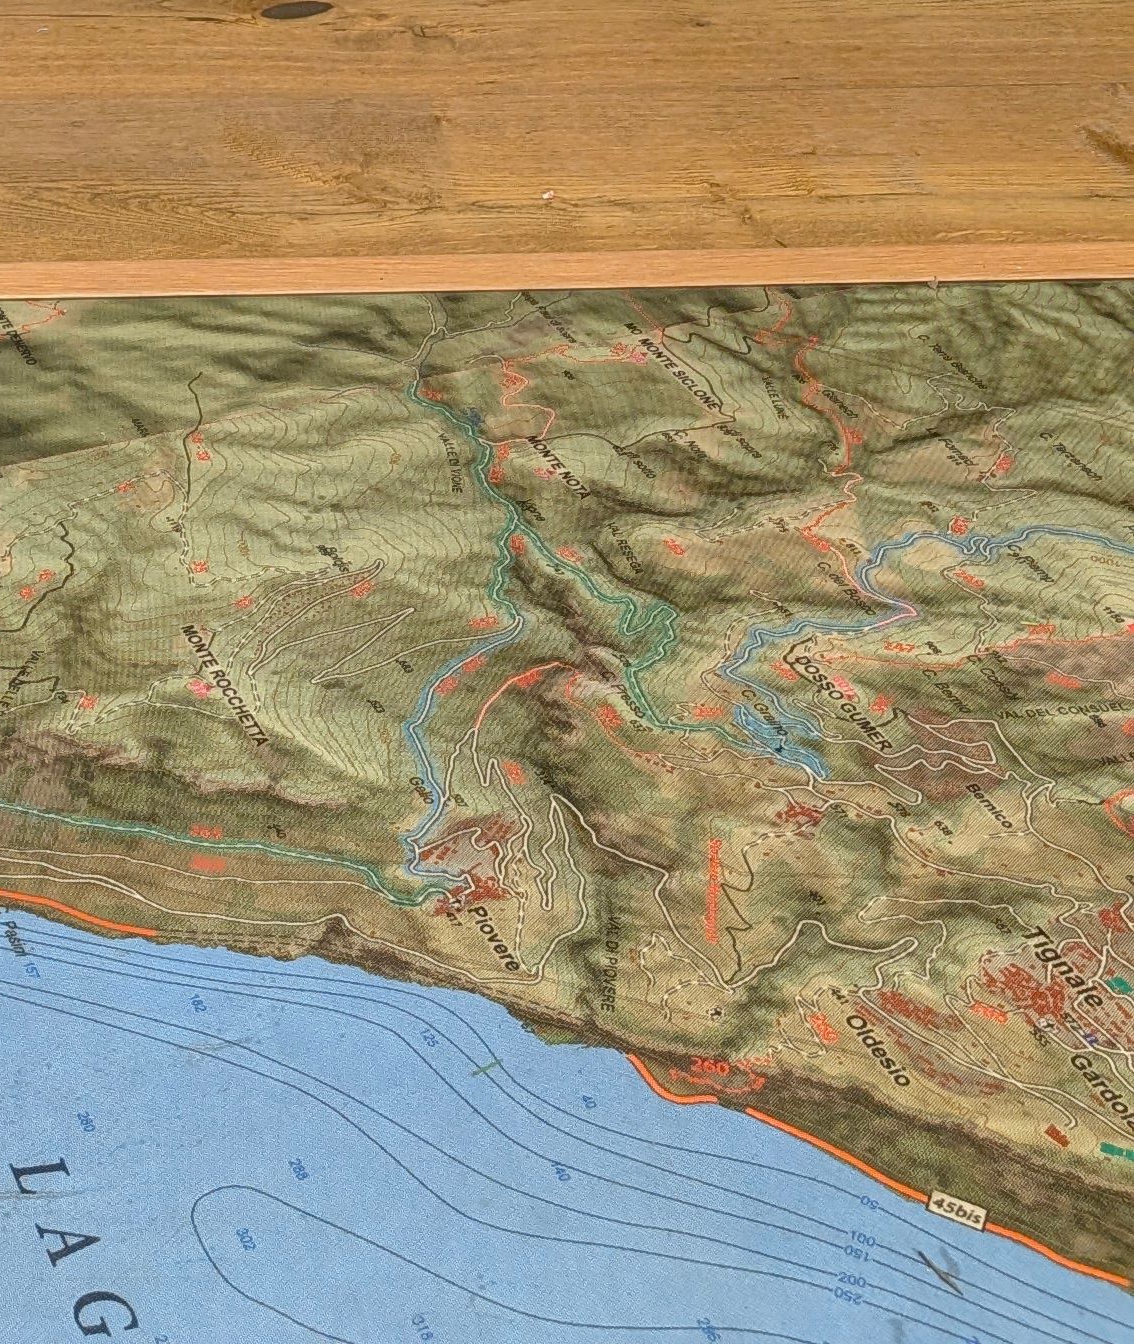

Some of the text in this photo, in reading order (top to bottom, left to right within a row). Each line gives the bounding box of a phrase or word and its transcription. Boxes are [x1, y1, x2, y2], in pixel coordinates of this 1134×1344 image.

[638, 338, 720, 411] MONTE SICLONE
[527, 435, 563, 472] MONTE
[560, 470, 591, 500] NOTA
[616, 537, 641, 575] RESEGA
[180, 624, 269, 748] MONTE ROCCHETTA
[794, 655, 894, 752] DOSSO GUMER
[1025, 701, 1130, 717] DEL CONSUEL
[752, 699, 788, 738] Graino
[933, 819, 953, 837] 638
[467, 905, 520, 973] Piovere
[1022, 926, 1104, 1009] Tignale
[419, 1027, 440, 1048] 125
[845, 1014, 911, 1088] Oldesio
[690, 1058, 730, 1076] 260
[77, 1111, 96, 1133] 280
[931, 1197, 983, 1225] 45bis
[235, 1226, 257, 1252] 302
[848, 1229, 877, 1247] 100
[836, 1271, 868, 1289] 200
[833, 1287, 863, 1305] 250
